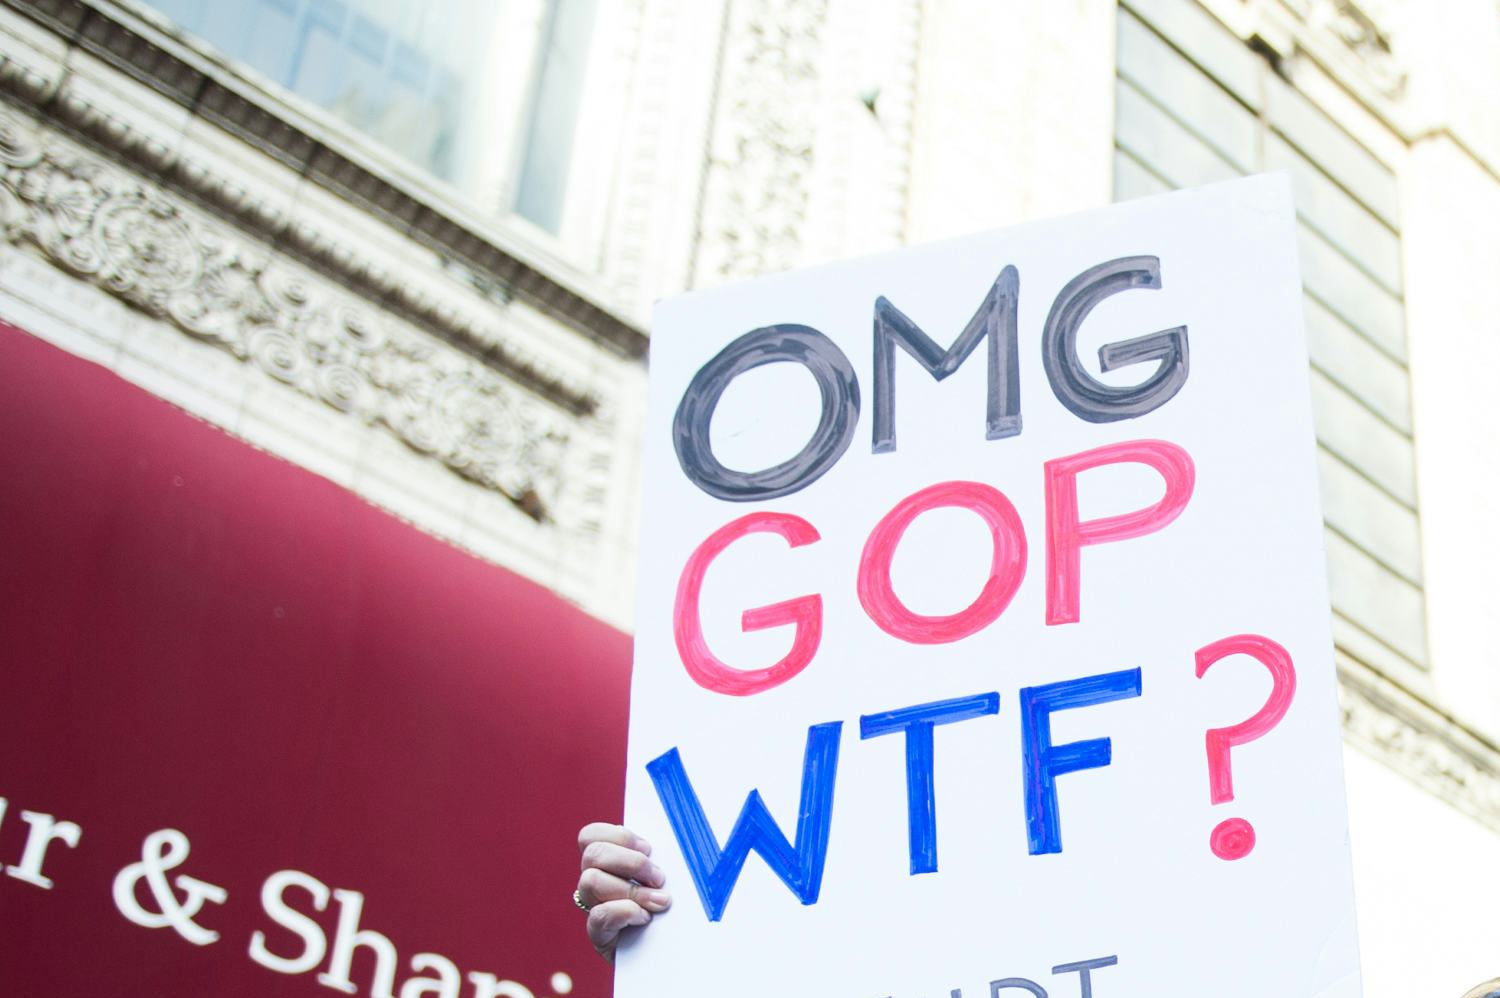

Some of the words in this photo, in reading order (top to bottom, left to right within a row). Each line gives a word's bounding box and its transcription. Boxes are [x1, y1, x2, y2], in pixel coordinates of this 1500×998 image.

[672, 255, 1189, 502] OMG
[673, 439, 1195, 696] GOP
[112, 829, 227, 945] &
[645, 667, 1141, 922] WTF
